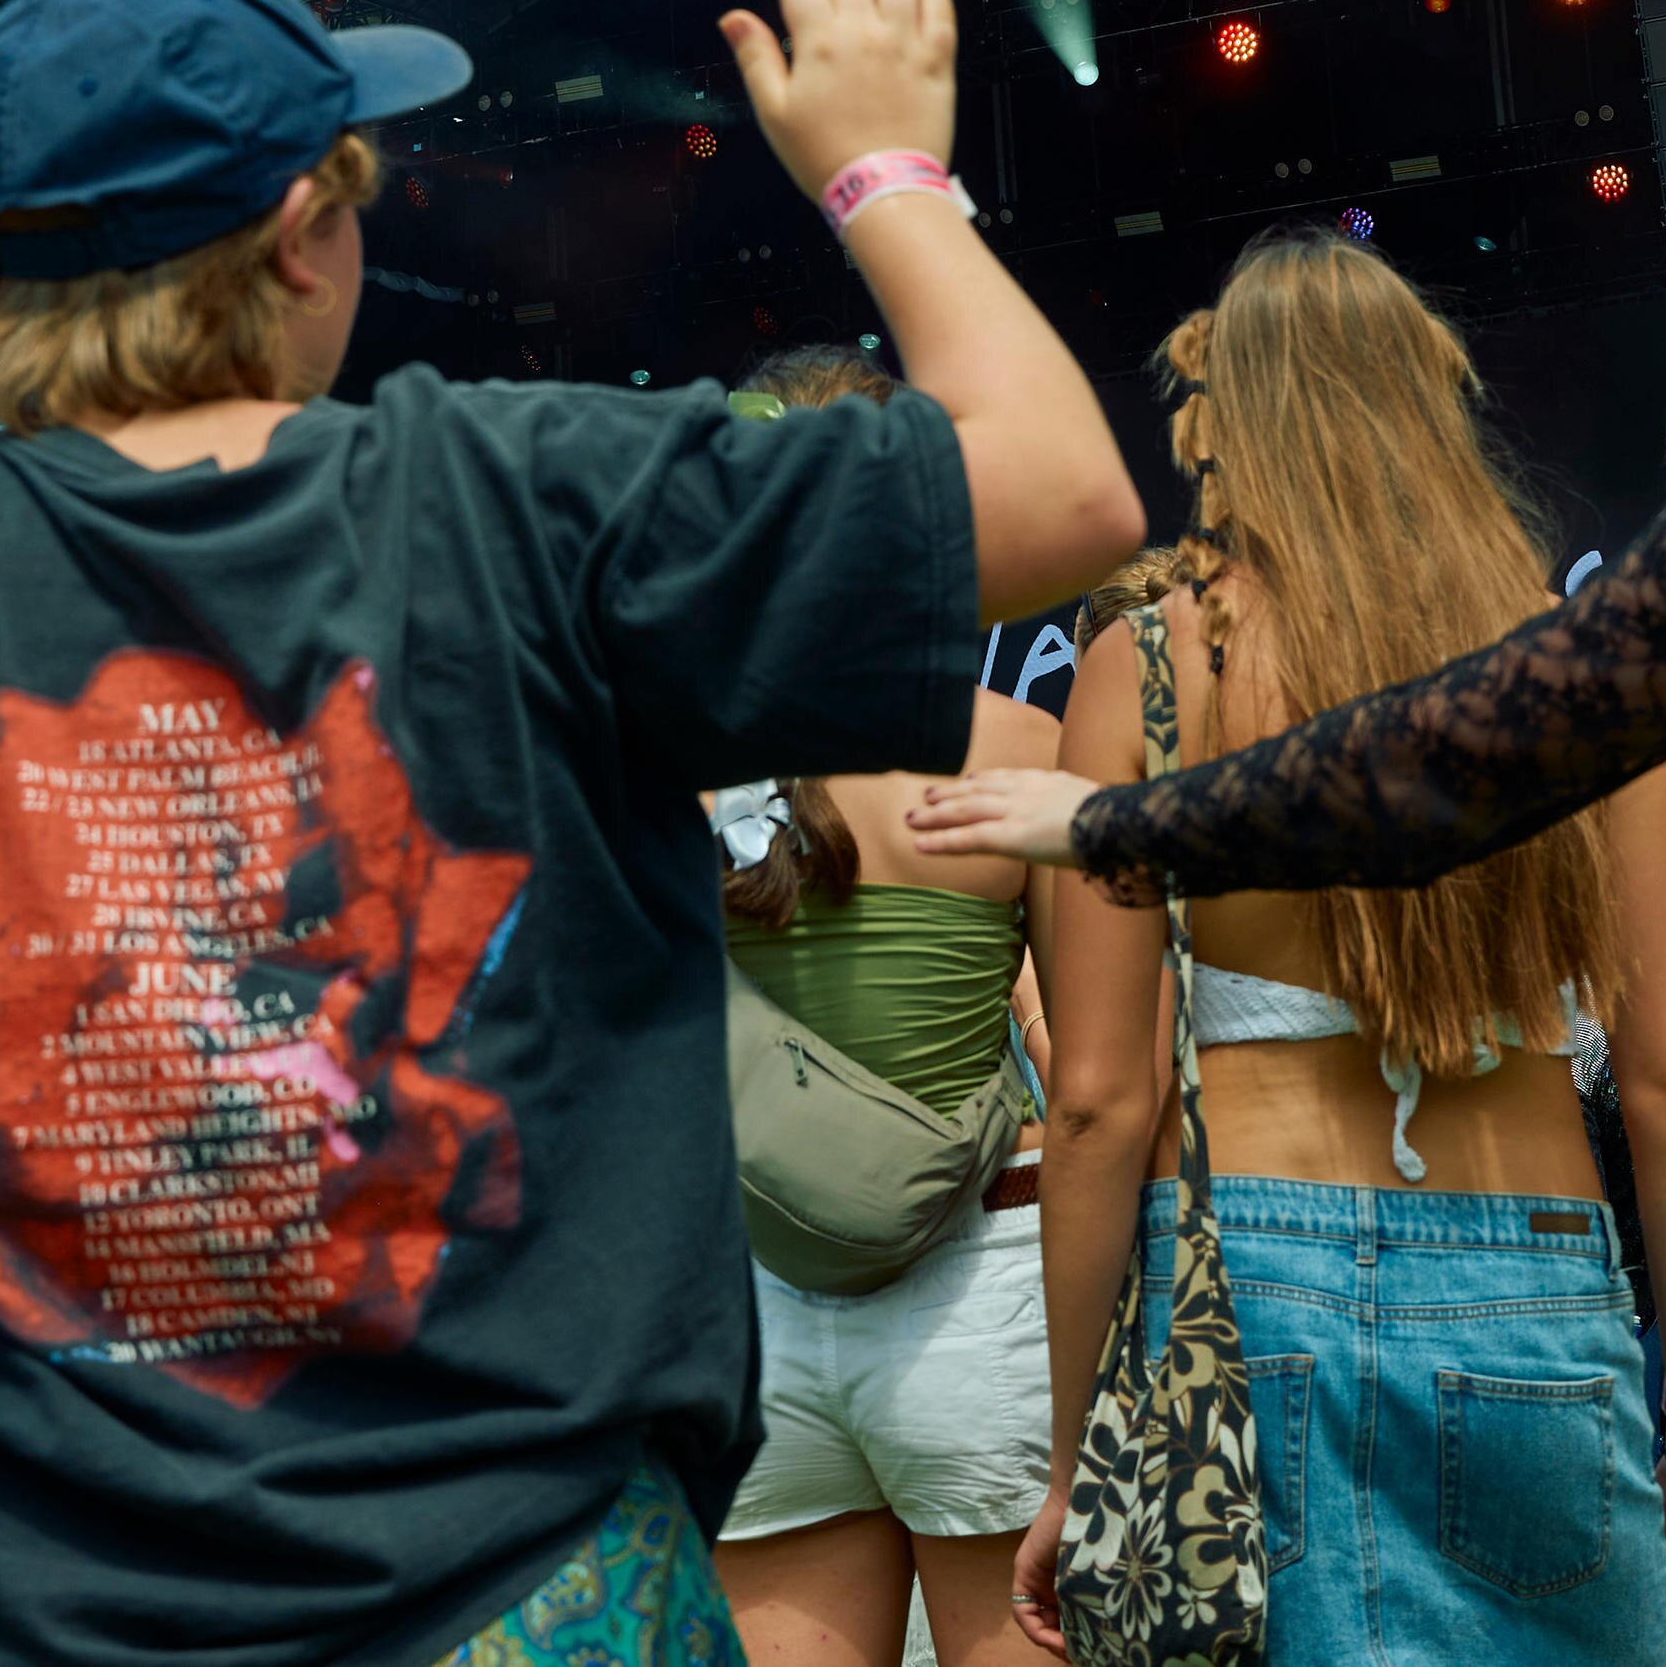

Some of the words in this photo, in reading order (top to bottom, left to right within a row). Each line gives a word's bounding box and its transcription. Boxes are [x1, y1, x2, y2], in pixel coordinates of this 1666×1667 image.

[138, 699, 225, 735] MAY
[112, 735, 240, 762] ATLANTA,
[47, 766, 120, 792] WEST
[128, 765, 205, 792] PALM
[97, 795, 162, 819] NEW
[252, 814, 284, 838] TX
[239, 843, 272, 867] TX
[65, 873, 94, 898] 27
[97, 877, 150, 902] LAS
[228, 901, 266, 925] CA
[103, 930, 158, 955] LOS
[294, 915, 334, 940] CA
[128, 961, 237, 996] JUNE
[93, 999, 146, 1025] SAN
[253, 990, 295, 1018] CA
[59, 1024, 205, 1056] MOUNTAIN
[292, 1013, 333, 1038] CA
[81, 1058, 151, 1084] WEST
[273, 1075, 316, 1099] CO
[33, 1116, 185, 1148] MARYLAND
[98, 1146, 192, 1175] TINLEY
[285, 1221, 331, 1245] MA
